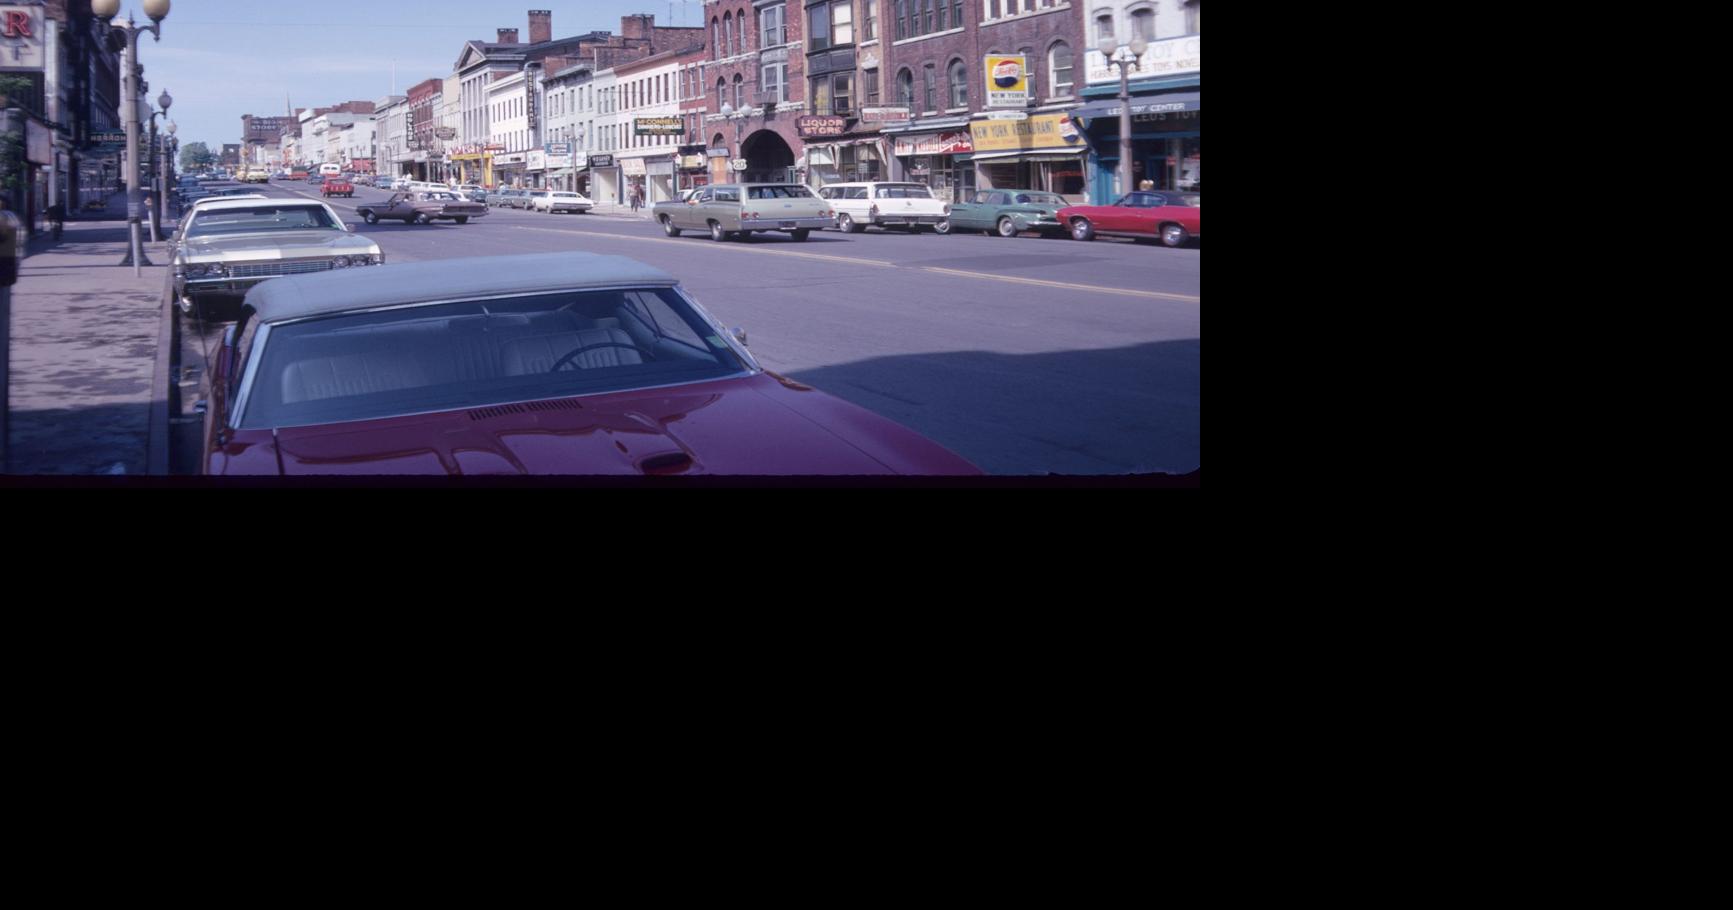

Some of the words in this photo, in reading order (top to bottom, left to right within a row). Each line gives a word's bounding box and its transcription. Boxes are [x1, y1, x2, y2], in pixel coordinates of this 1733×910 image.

[1150, 102, 1185, 112] CENTER
[801, 118, 844, 128] LIQUOR
[803, 126, 842, 135] STORE
[972, 125, 988, 140] NEW
[991, 123, 1009, 138] YORK
[1012, 119, 1056, 137] RESTAURANT
[734, 160, 745, 169] 20
